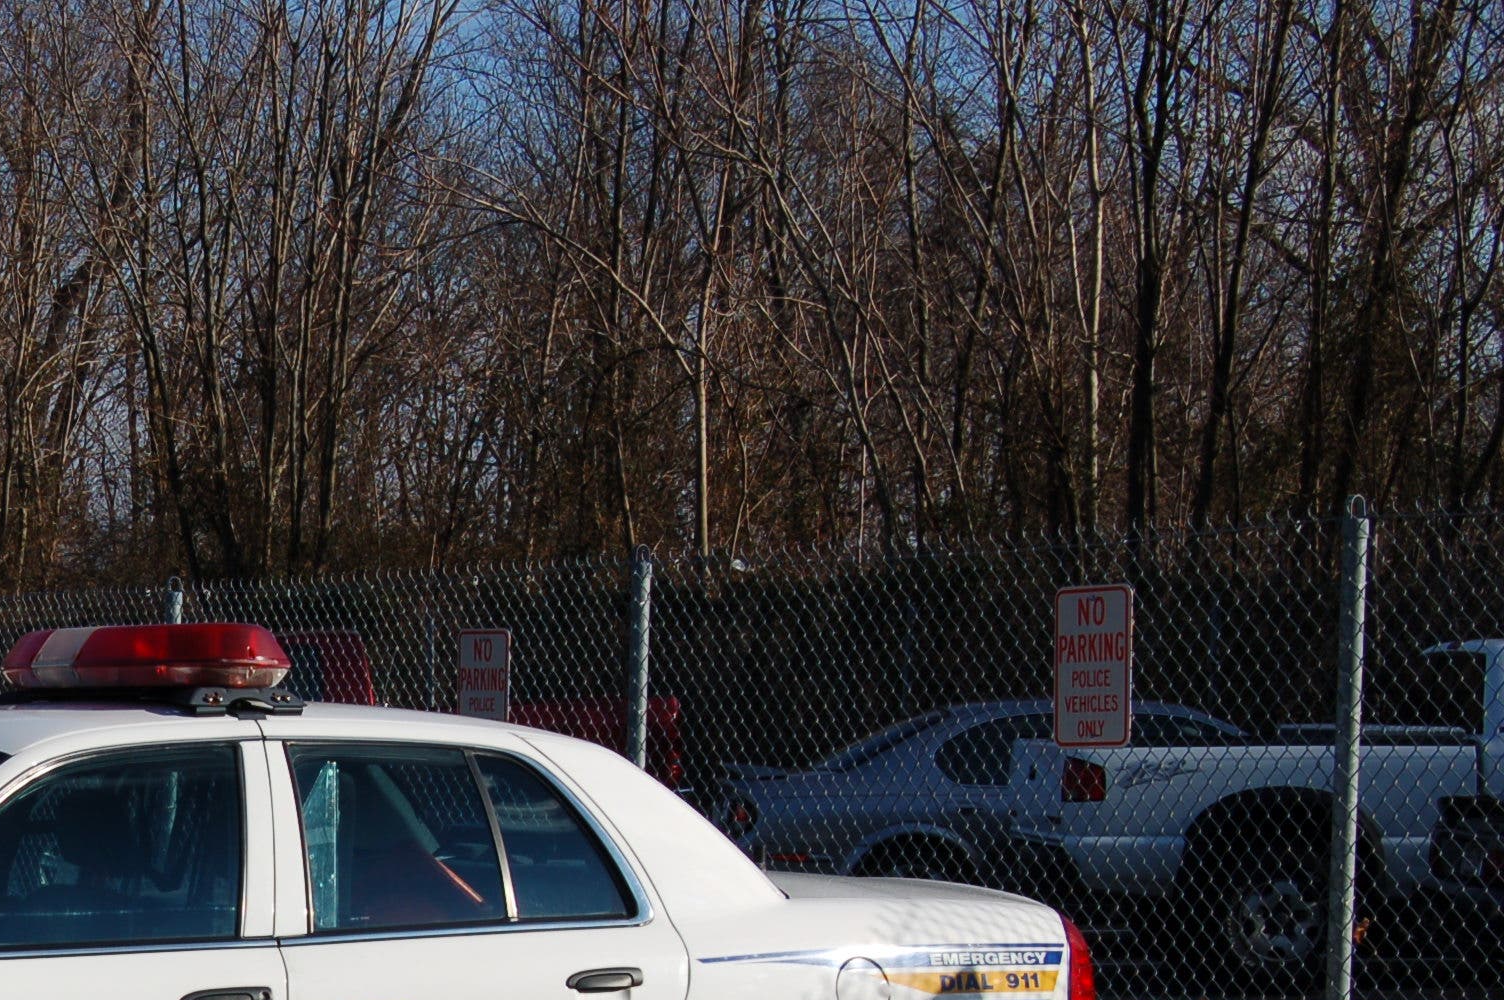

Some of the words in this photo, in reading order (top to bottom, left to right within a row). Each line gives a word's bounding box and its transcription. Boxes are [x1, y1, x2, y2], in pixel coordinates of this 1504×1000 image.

[1077, 597, 1105, 626] NO
[473, 639, 493, 662] NO
[1059, 632, 1125, 664] PARKING
[461, 668, 505, 691] PARKING
[1071, 669, 1111, 688] POLICE
[469, 697, 496, 712] POLICE
[1064, 694, 1118, 713] VEHICLES
[1077, 720, 1105, 738] ONLY
[929, 952, 1046, 965] EMERGENCY
[939, 972, 994, 991] DIAL
[1006, 972, 1040, 989] 911
